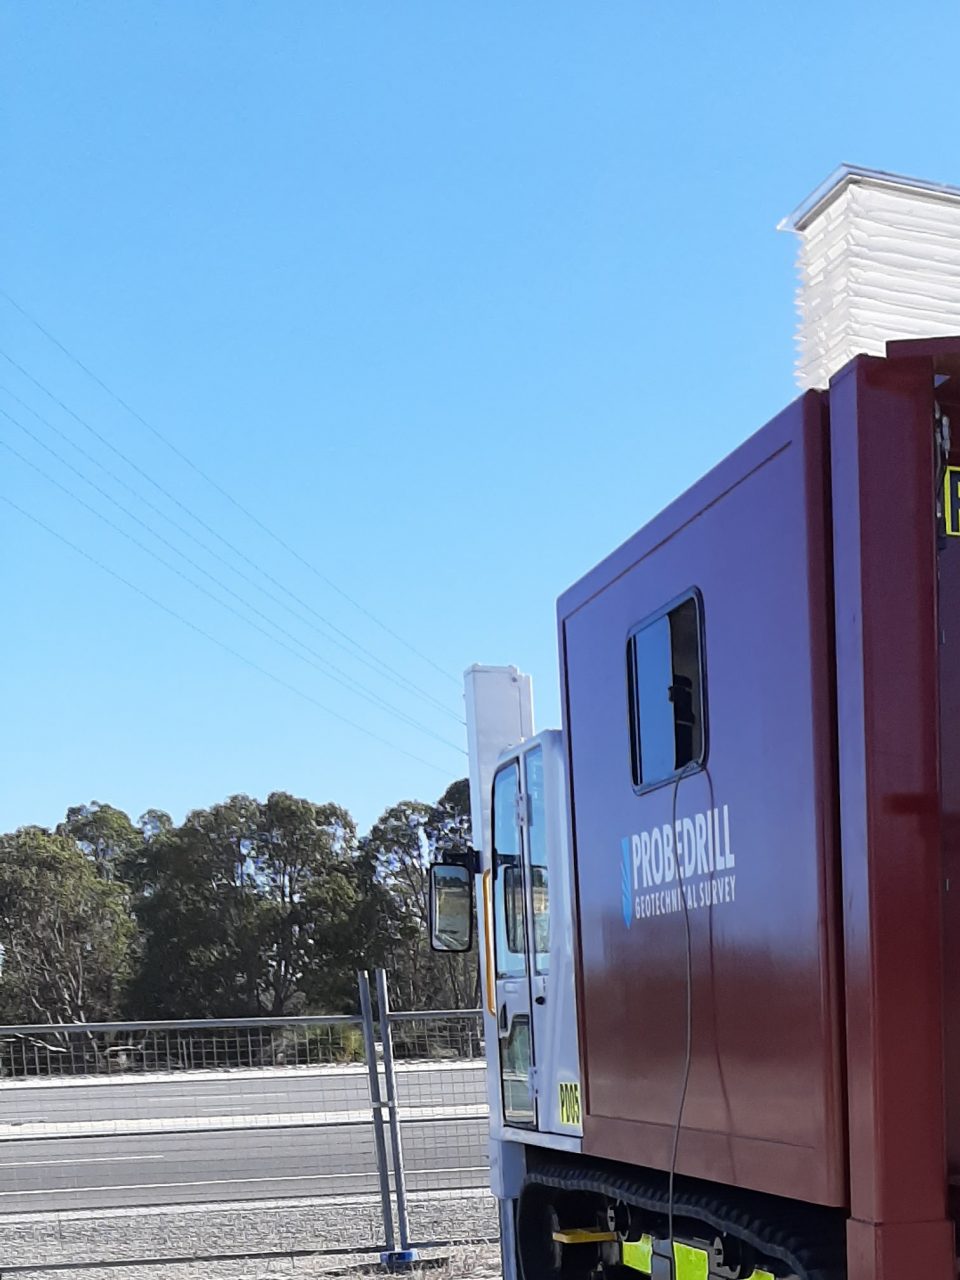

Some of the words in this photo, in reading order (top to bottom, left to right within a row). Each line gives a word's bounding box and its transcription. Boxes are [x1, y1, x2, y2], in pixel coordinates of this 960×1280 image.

[631, 804, 736, 890] PROBEDRILL
[699, 874, 736, 908] SURVEY
[559, 1083, 580, 1124] PD05
